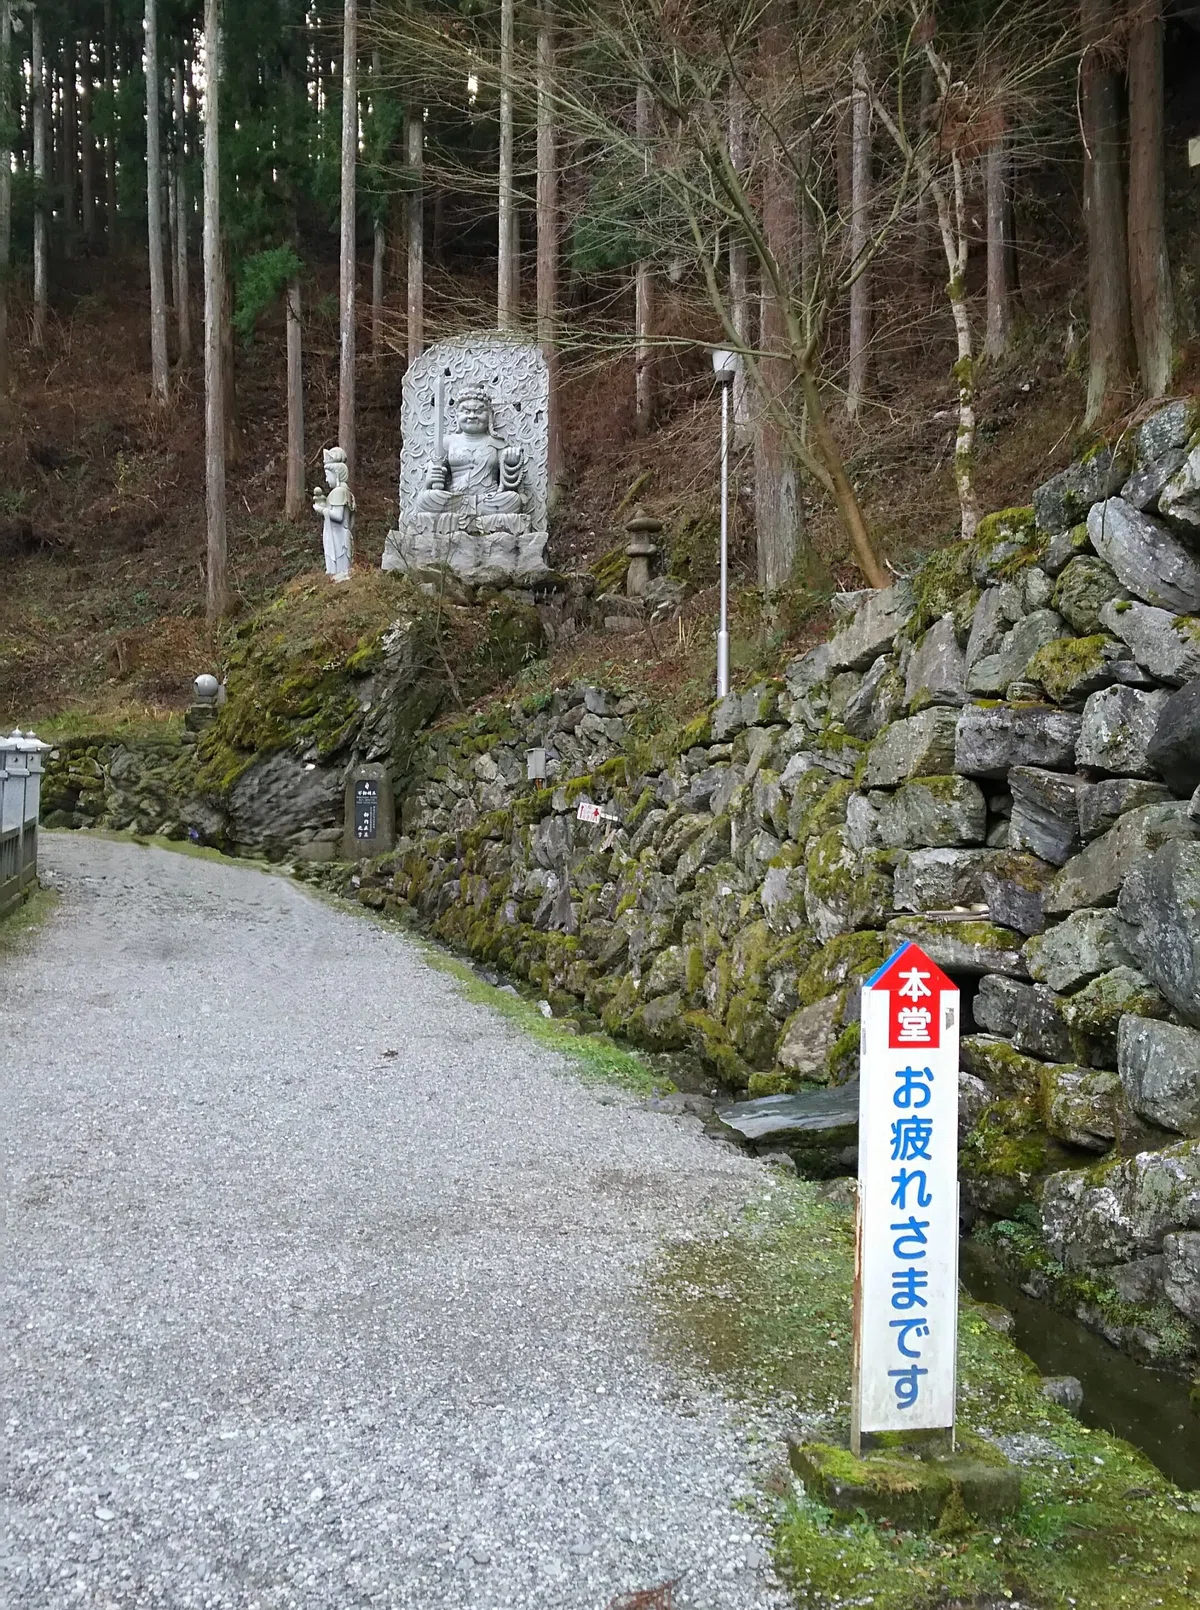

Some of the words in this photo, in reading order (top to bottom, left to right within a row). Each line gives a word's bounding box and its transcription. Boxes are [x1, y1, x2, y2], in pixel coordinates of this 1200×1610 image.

[898, 967, 931, 1042] 本堂
[888, 1065, 934, 1409] お疲れさまです
